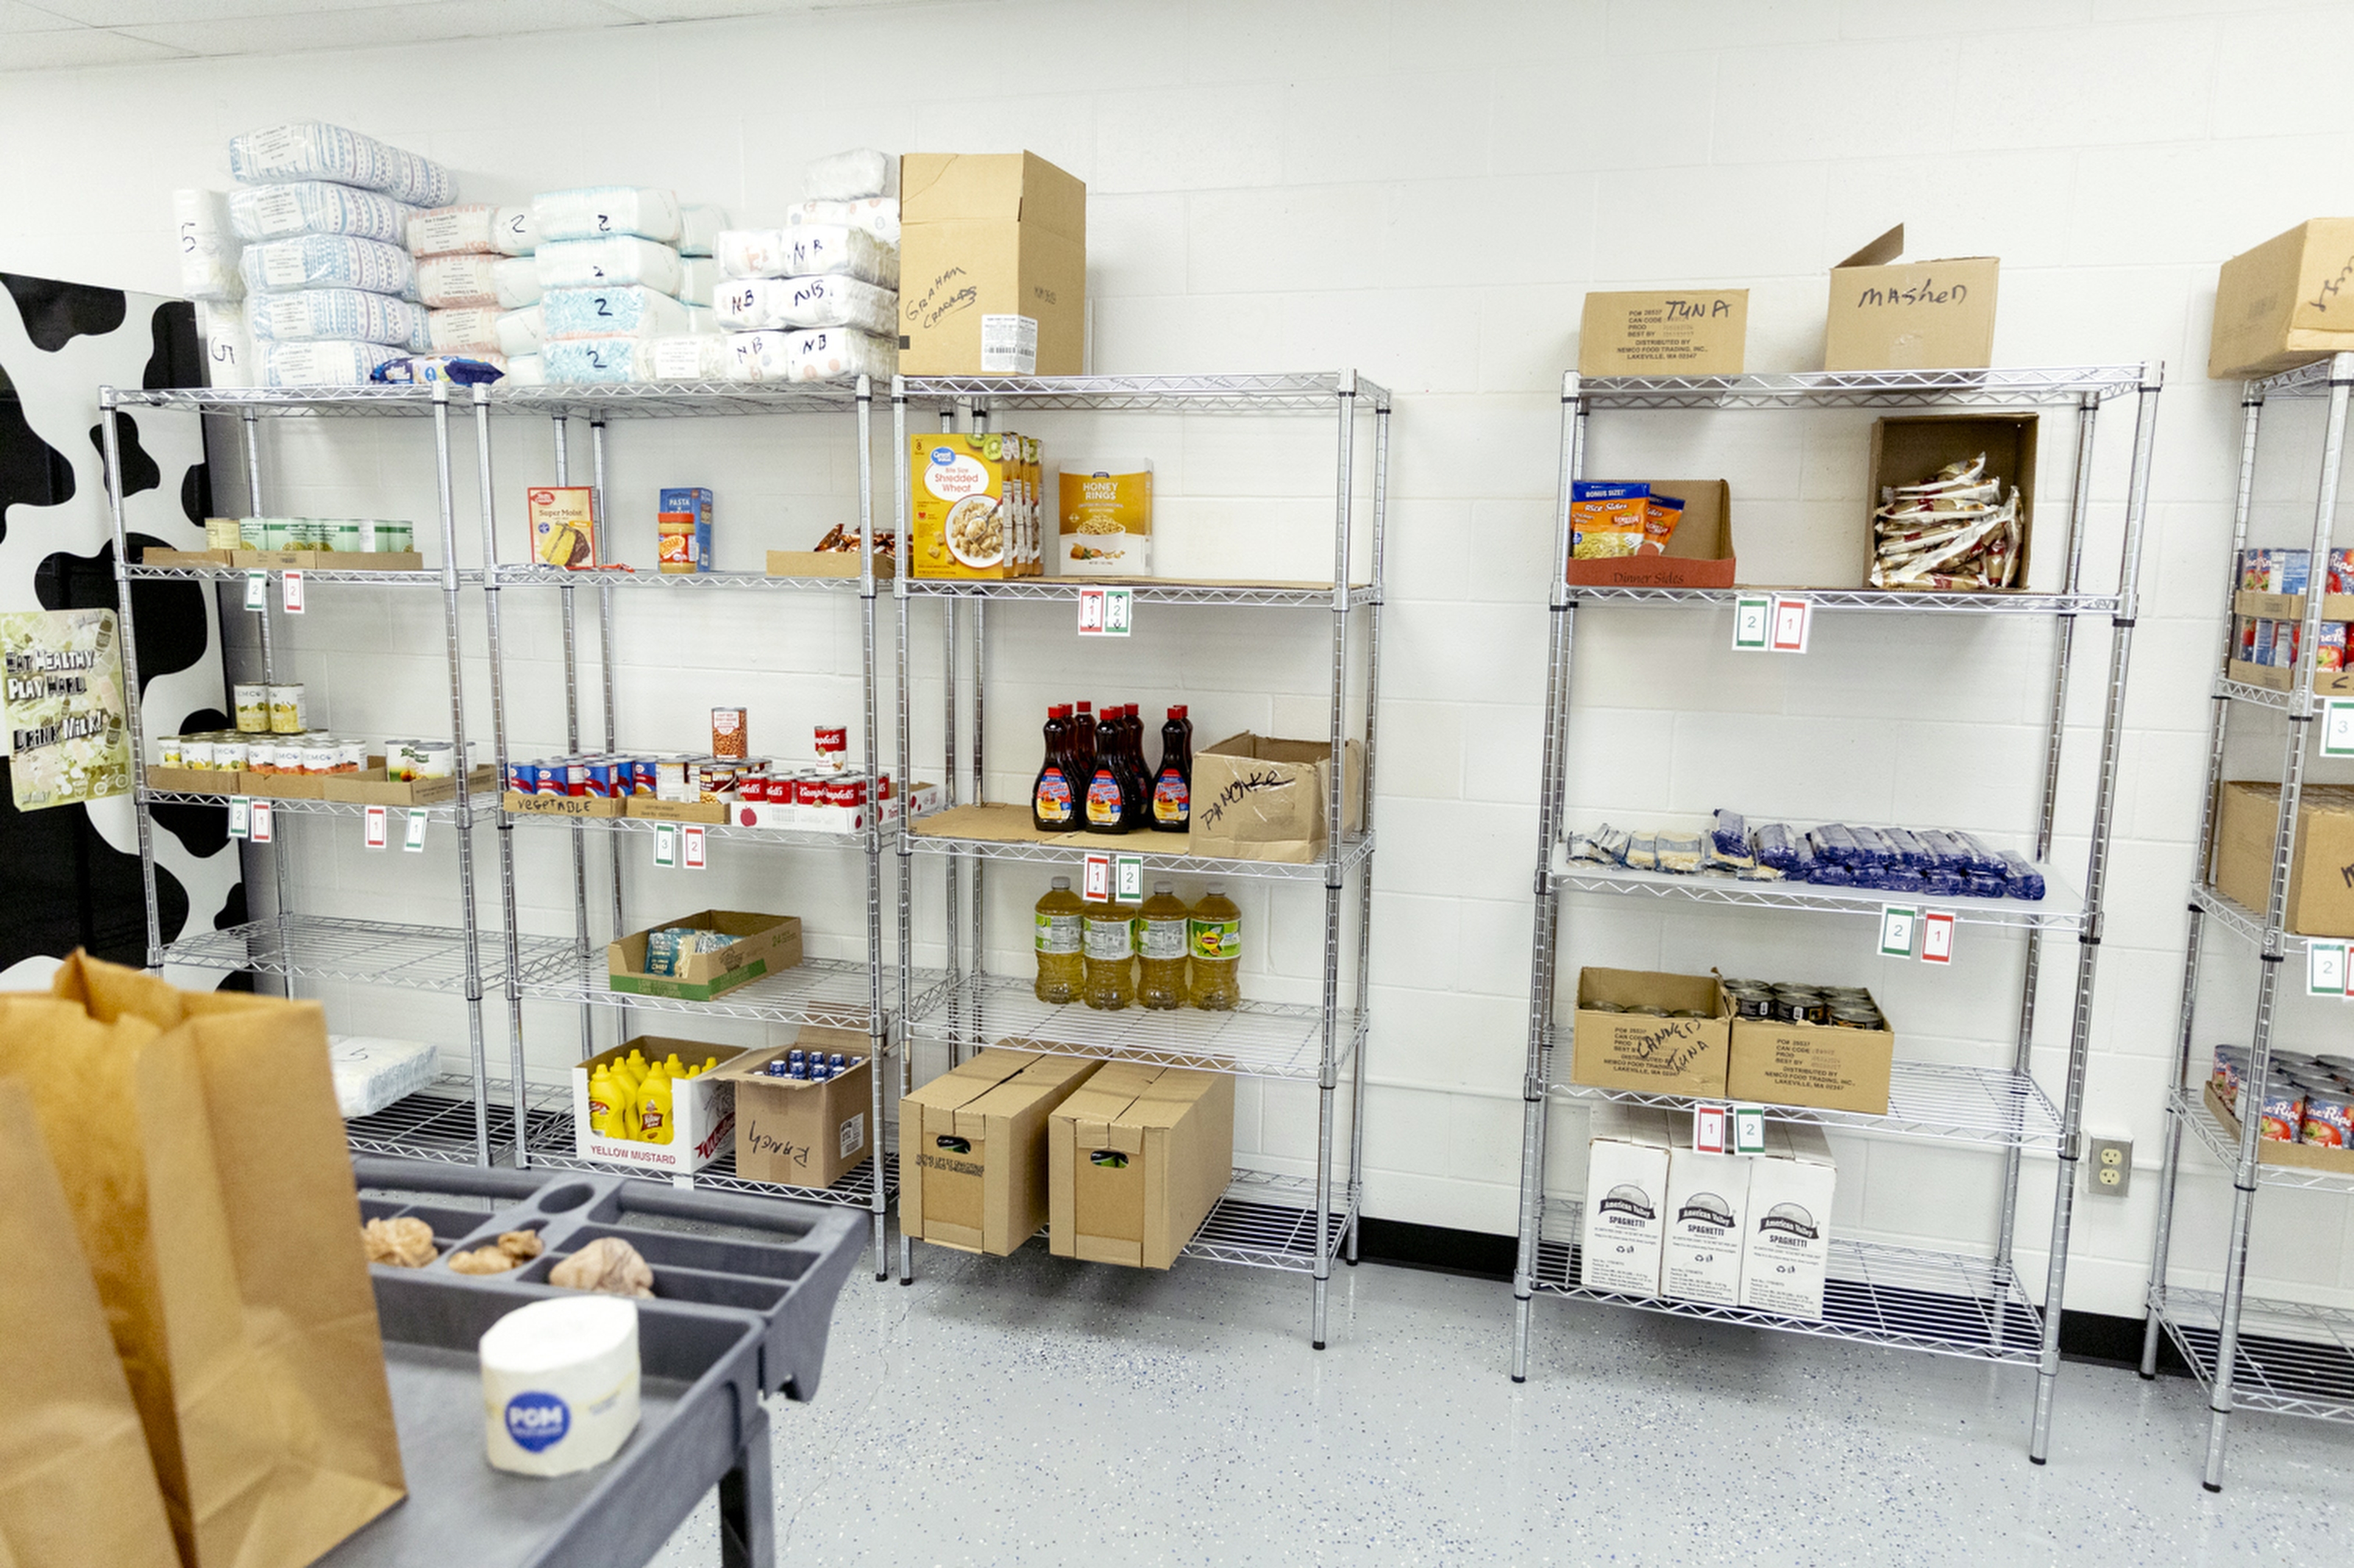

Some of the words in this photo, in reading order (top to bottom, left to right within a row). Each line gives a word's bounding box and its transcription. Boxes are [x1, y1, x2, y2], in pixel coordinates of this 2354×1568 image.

[511, 214, 526, 233] 2
[597, 214, 611, 232] 2
[181, 223, 197, 253] 5
[594, 266, 605, 277] 2
[906, 266, 967, 321] GRAHAM
[594, 298, 614, 316] 2
[1665, 299, 1732, 321] TUNA
[211, 335, 235, 366] 5
[587, 350, 608, 370] 2
[934, 473, 979, 483] Shredded
[942, 484, 971, 493] Wheat
[1083, 482, 1119, 492] HONEY
[1085, 491, 1117, 501] RINGS
[1613, 571, 1652, 585] Dinner
[1654, 572, 1685, 585] Sides
[1113, 605, 1121, 617] 2
[1747, 616, 1757, 629] 2
[1787, 618, 1793, 630] 1
[2338, 720, 2349, 734] 3
[235, 810, 243, 821] 2
[661, 838, 668, 849] 3
[691, 841, 699, 852] 2
[1095, 871, 1100, 882] 1
[1126, 871, 1134, 883] 2
[1893, 924, 1903, 938] 2
[1934, 930, 1941, 943] 1
[2322, 961, 2333, 974] 2
[1668, 1041, 1709, 1075] TUNA
[1707, 1123, 1714, 1134] 1
[1746, 1123, 1755, 1136] 2
[590, 1144, 629, 1159] YELLOW
[630, 1149, 677, 1165] MUSTARD
[1609, 1216, 1646, 1228] SPAGHETTI
[1688, 1224, 1725, 1236] SPAGHETTI
[1769, 1235, 1807, 1248] SPAGHETTI
